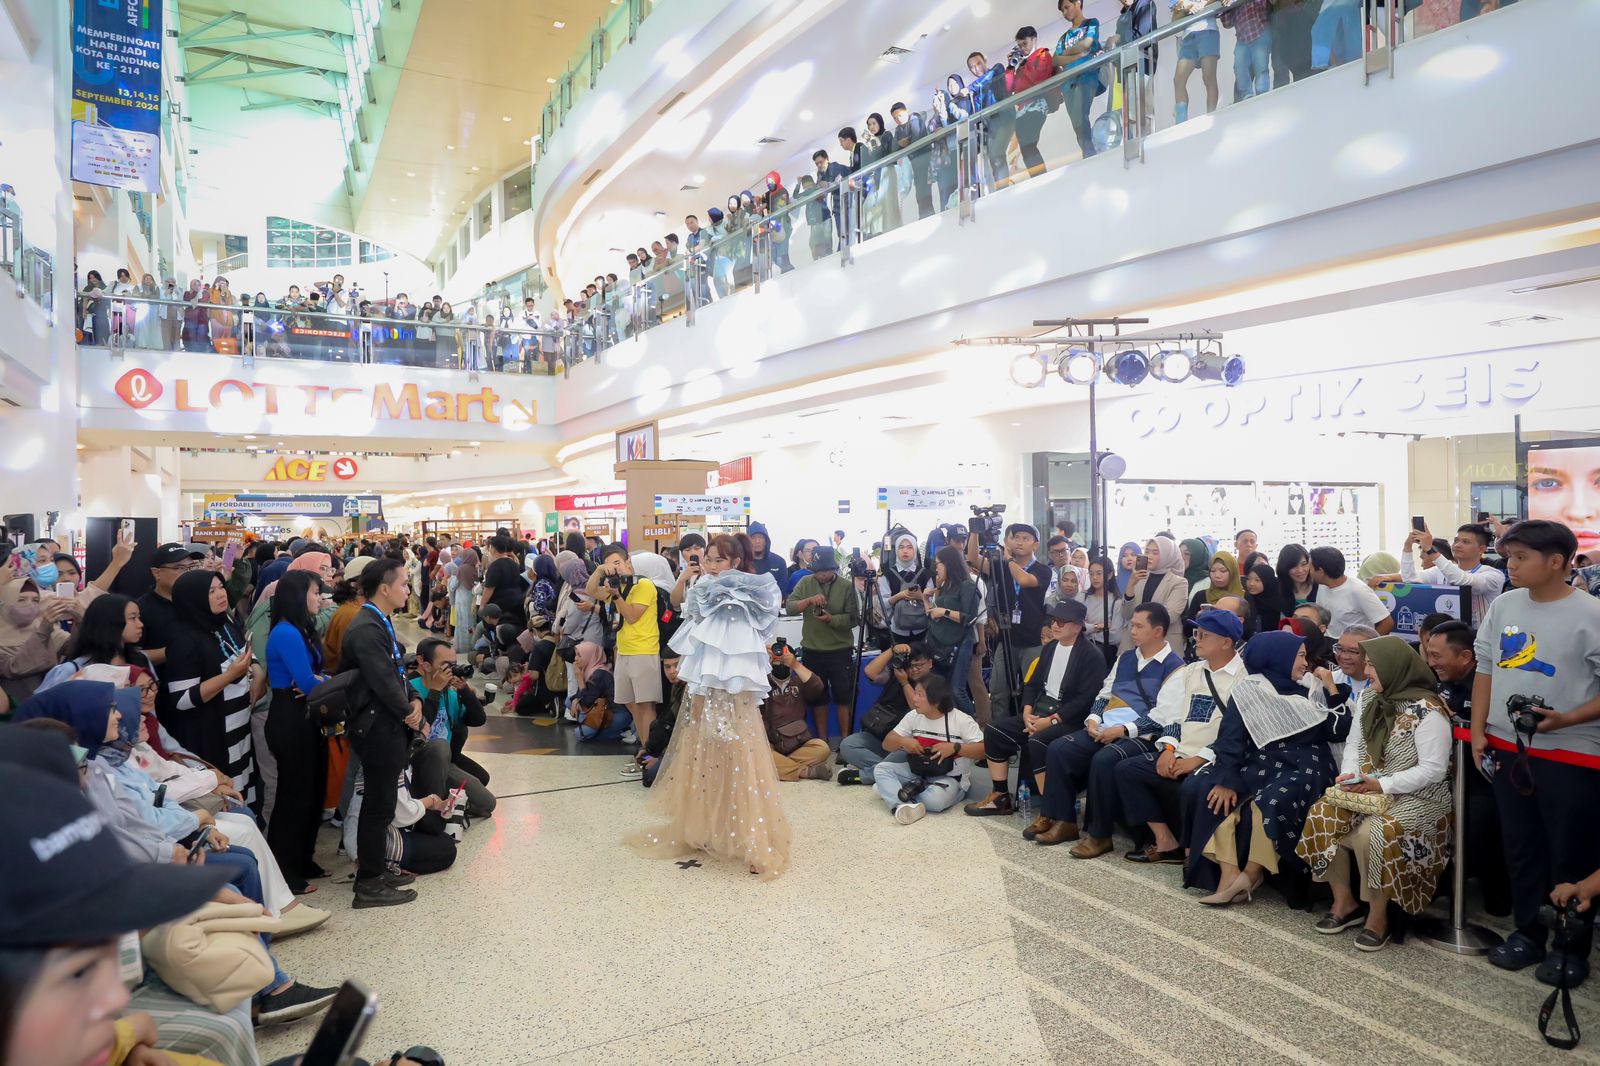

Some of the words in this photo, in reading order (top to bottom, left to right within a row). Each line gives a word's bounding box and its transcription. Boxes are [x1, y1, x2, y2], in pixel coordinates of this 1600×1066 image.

[77, 25, 160, 50] MEMPERINGATI
[89, 39, 118, 52] HARI
[121, 45, 147, 57] JADI
[75, 45, 104, 59] KOTA
[106, 52, 160, 69] BANDUNG
[96, 61, 111, 70] KE
[120, 65, 141, 75] 214
[75, 88, 133, 107] SEPTEMBER
[135, 100, 160, 111] 2024
[118, 88, 160, 101] 13,14,15
[371, 382, 501, 424] Mart
[627, 432, 647, 460] KAI
[264, 455, 329, 482] ACE
[644, 527, 672, 537] BLIBLI
